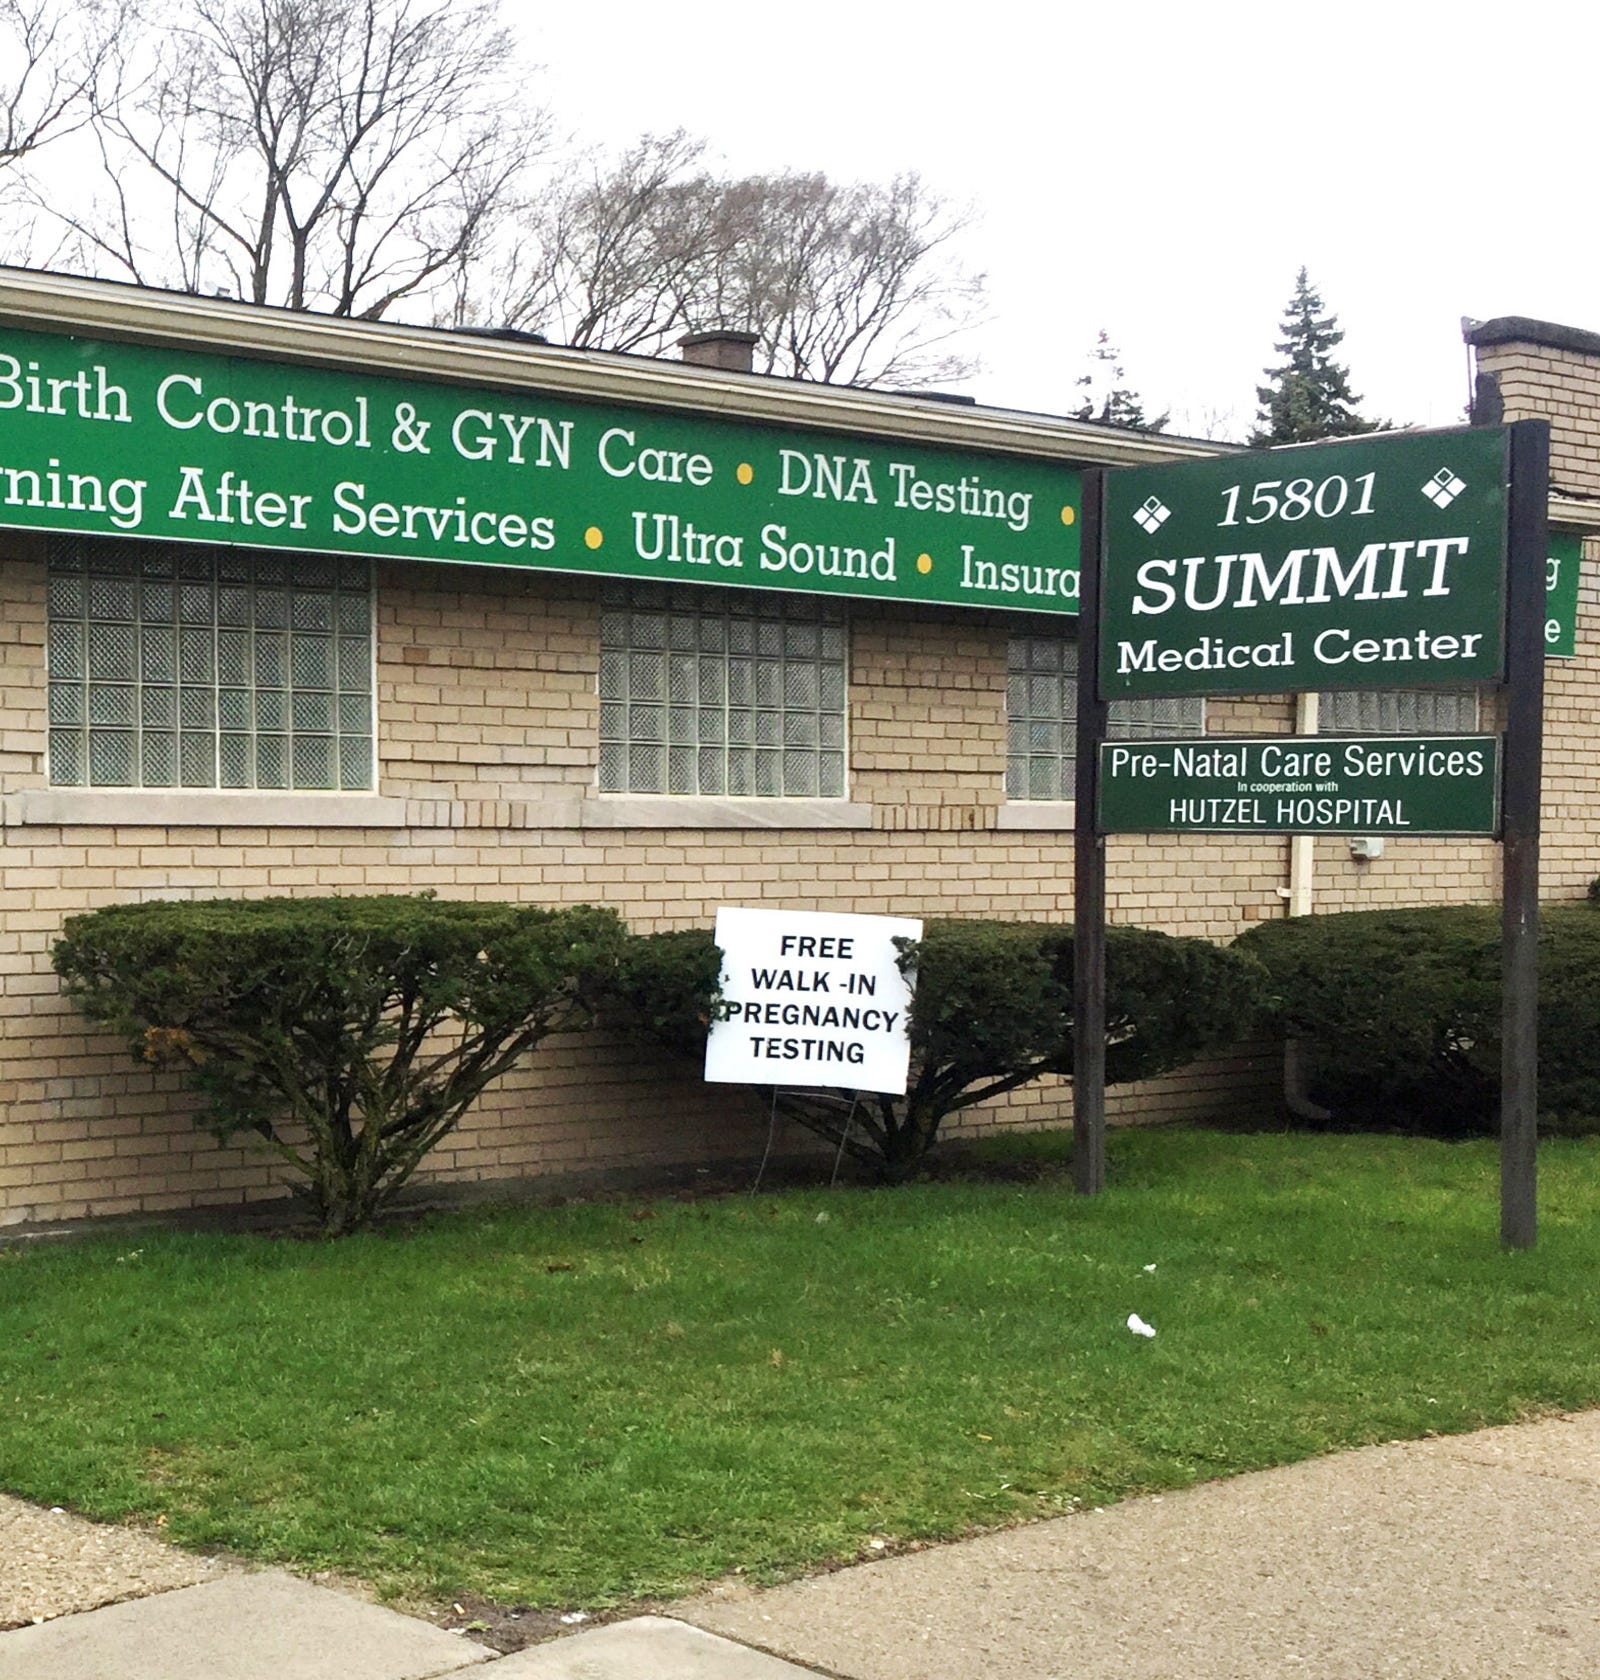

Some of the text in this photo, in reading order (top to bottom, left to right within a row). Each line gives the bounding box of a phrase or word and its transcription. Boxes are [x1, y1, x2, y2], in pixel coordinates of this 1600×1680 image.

[156, 374, 371, 448] Control
[391, 402, 431, 454] &
[452, 409, 575, 470] GYN
[598, 427, 713, 486] Care
[778, 449, 878, 505] DNA
[889, 463, 1033, 532] Testing
[1216, 471, 1376, 527] 15801
[168, 466, 313, 530] After
[332, 481, 556, 550] Services
[631, 511, 744, 567] Ultra
[759, 524, 897, 582] Sound
[1131, 536, 1470, 615] SUMMIT
[1116, 628, 1483, 674] Medical Center
[1110, 745, 1484, 777] Pre-Natal Care Services
[1237, 781, 1339, 794] In cooperation with
[1169, 799, 1411, 825] HUTZEL HOSPITAL
[780, 935, 854, 960] FREE
[751, 968, 830, 993] WALK
[725, 1002, 899, 1033] PREGNANCY
[749, 1036, 864, 1064] TESTING
